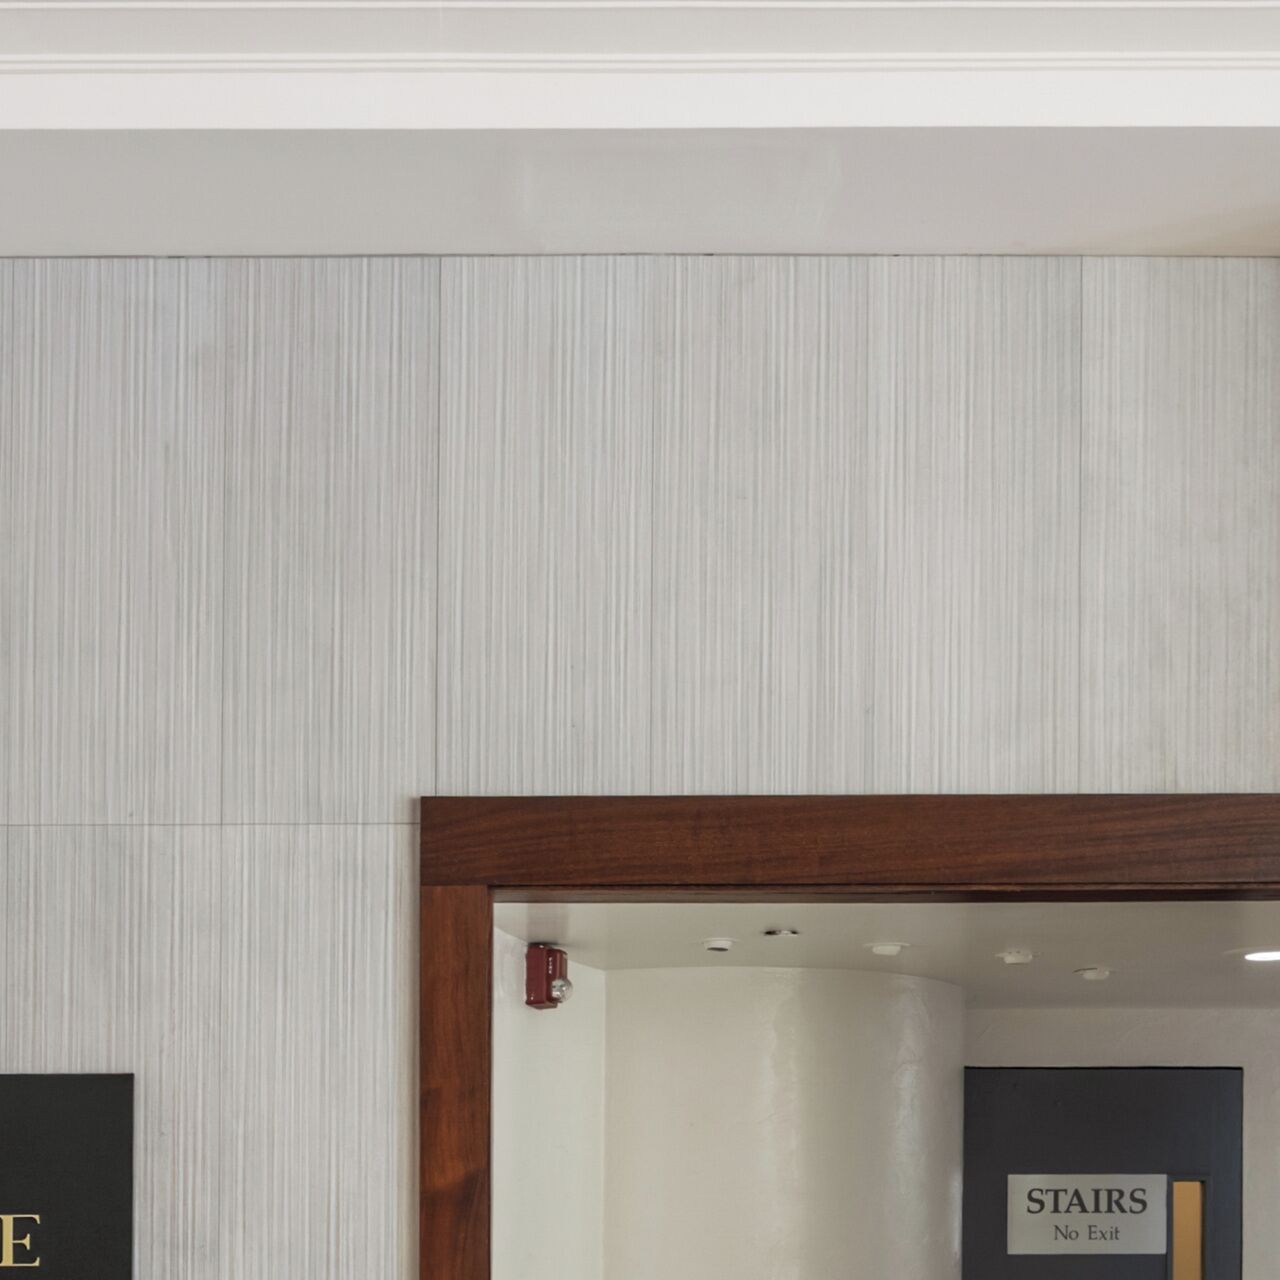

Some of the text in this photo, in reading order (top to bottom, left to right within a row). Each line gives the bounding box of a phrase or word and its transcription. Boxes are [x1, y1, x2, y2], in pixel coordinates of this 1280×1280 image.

[1026, 1187, 1148, 1215] STAIRS
[1053, 1224, 1121, 1241] No Exit
